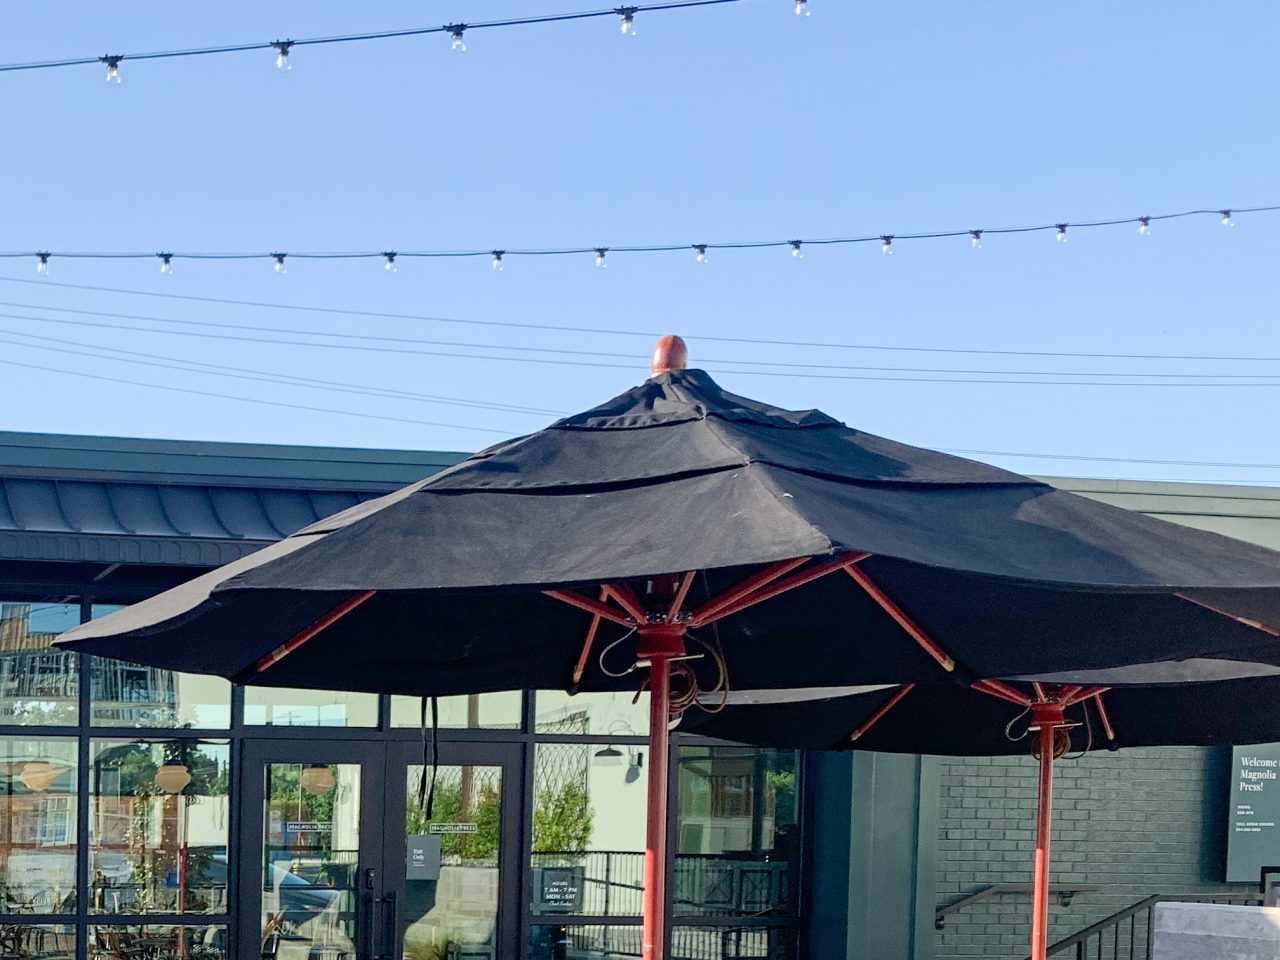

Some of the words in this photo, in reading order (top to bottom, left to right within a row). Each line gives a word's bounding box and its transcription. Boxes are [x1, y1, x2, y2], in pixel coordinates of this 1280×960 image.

[1241, 756, 1278, 768] Welcome
[1240, 769, 1277, 782] Magnolia
[1239, 781, 1264, 792] Press!
